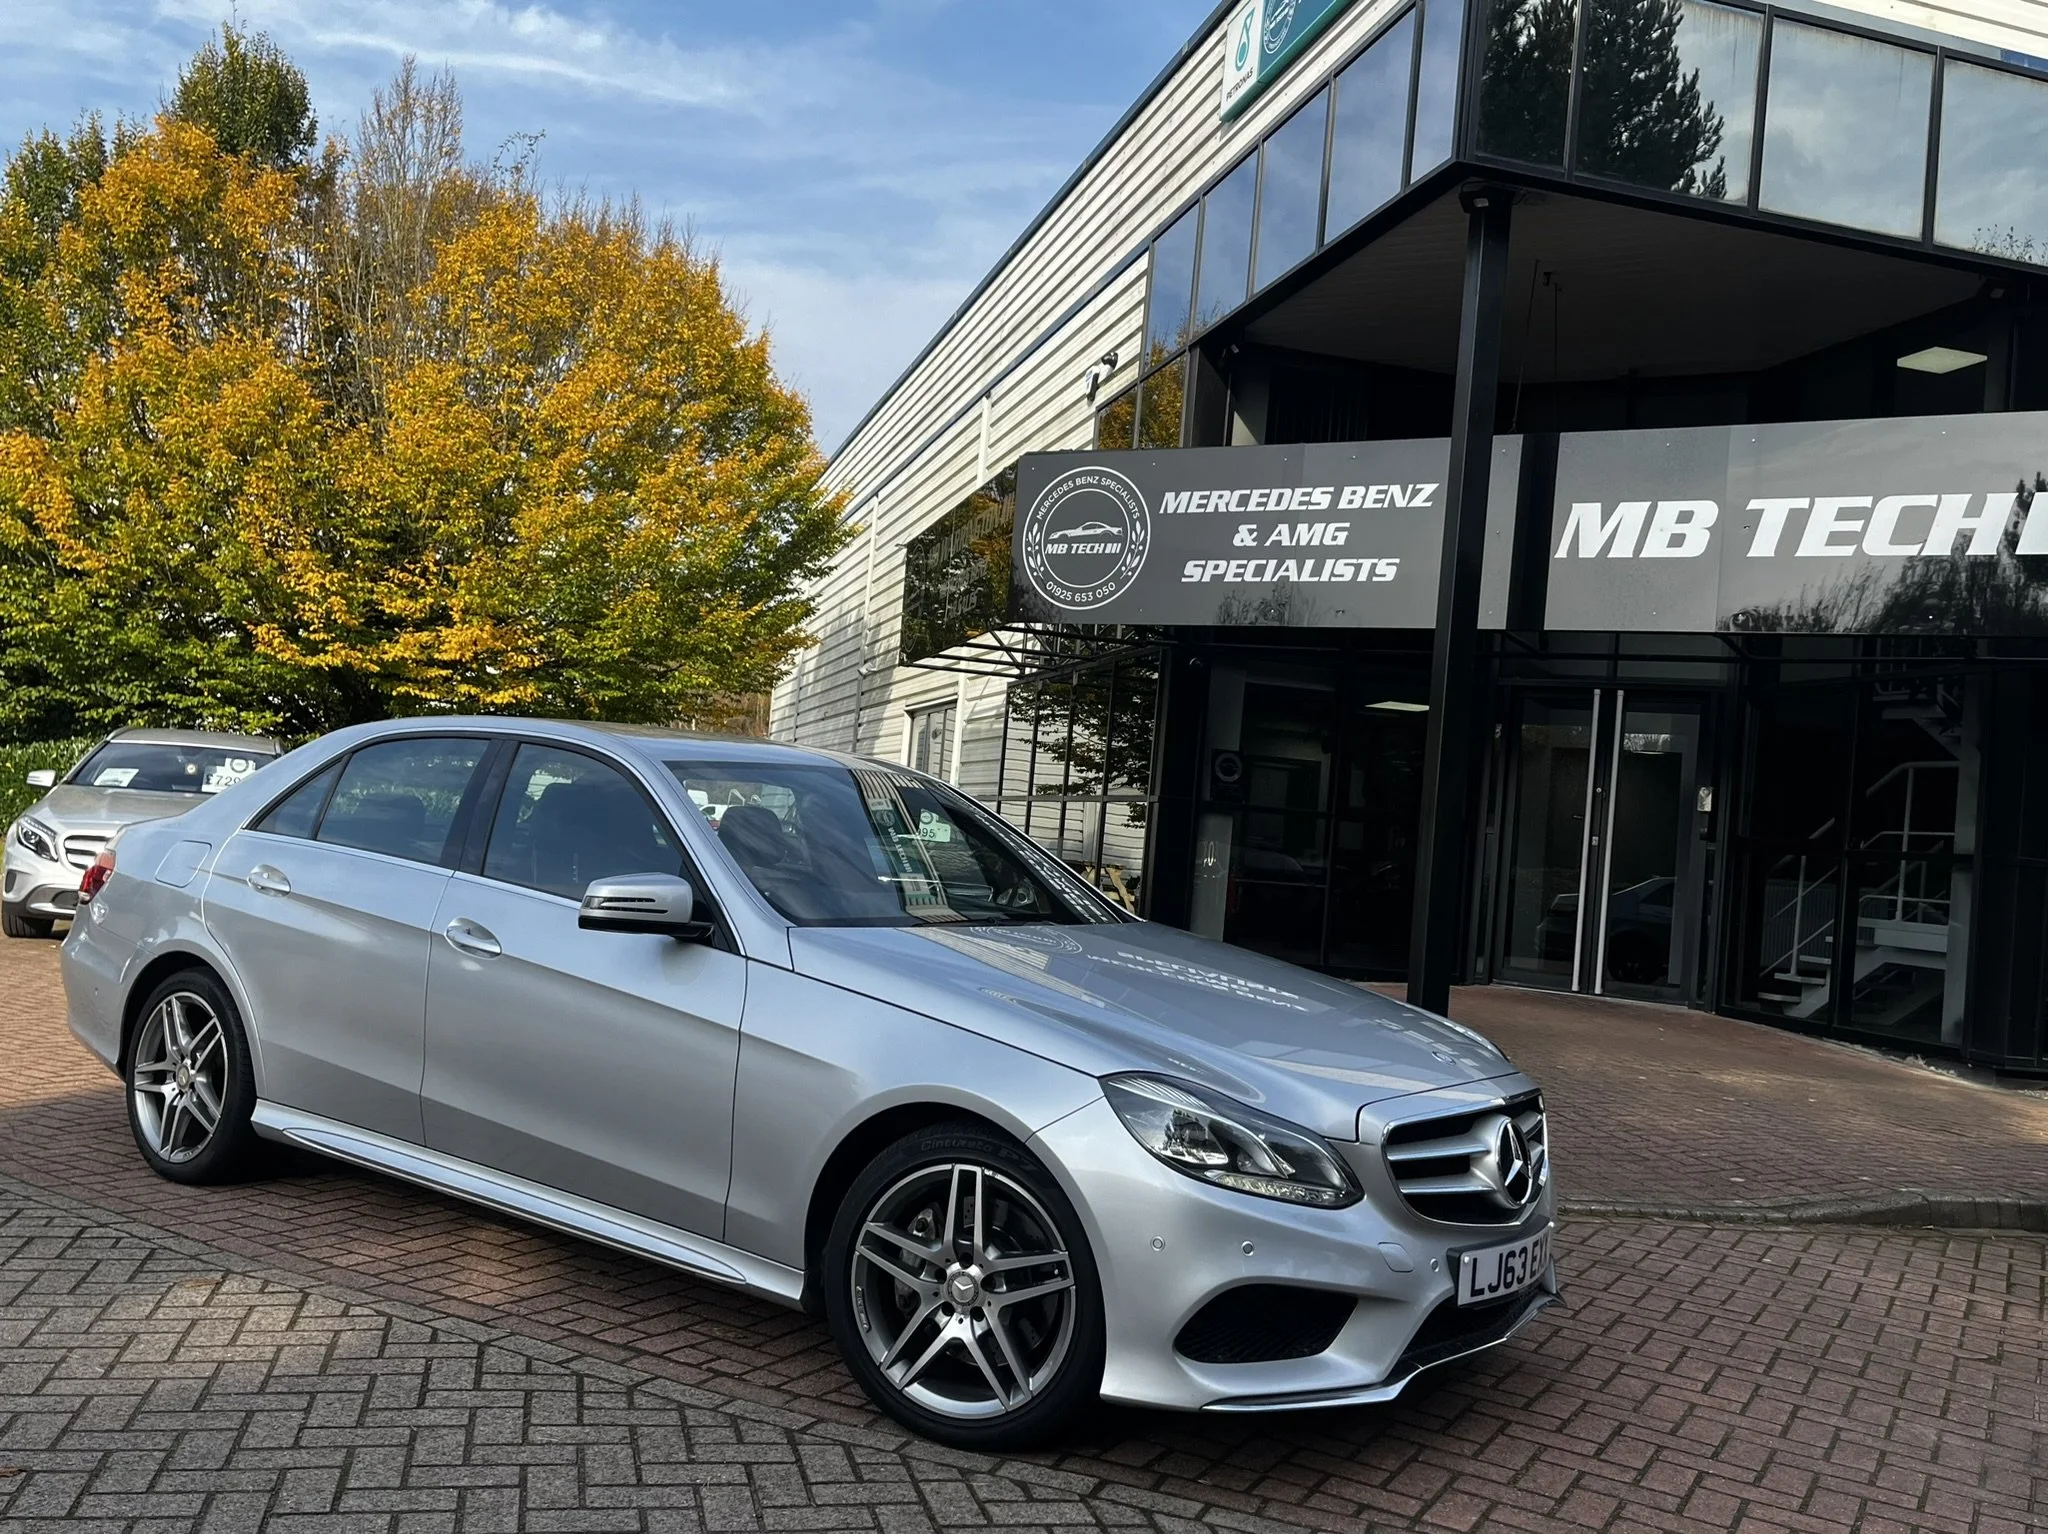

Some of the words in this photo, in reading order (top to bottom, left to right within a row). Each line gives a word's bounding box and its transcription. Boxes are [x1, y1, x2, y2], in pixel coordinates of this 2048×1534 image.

[1036, 480, 1074, 520] MERCEDES
[1075, 475, 1100, 486] BENZ
[1100, 477, 1140, 520] SPECIALISTS
[1159, 486, 1334, 514] MERCEDES
[1336, 483, 1440, 511] BENZ
[1232, 523, 1258, 548] &
[1264, 521, 1351, 547] AMG
[1553, 499, 1720, 559] MB
[1044, 542, 1069, 555] MB
[1181, 557, 1401, 583] SPECIALISTS
[1045, 581, 1073, 601] 01925
[1074, 591, 1094, 602] 653
[1095, 581, 1116, 598] 050
[1470, 1246, 1528, 1298] LJ63
